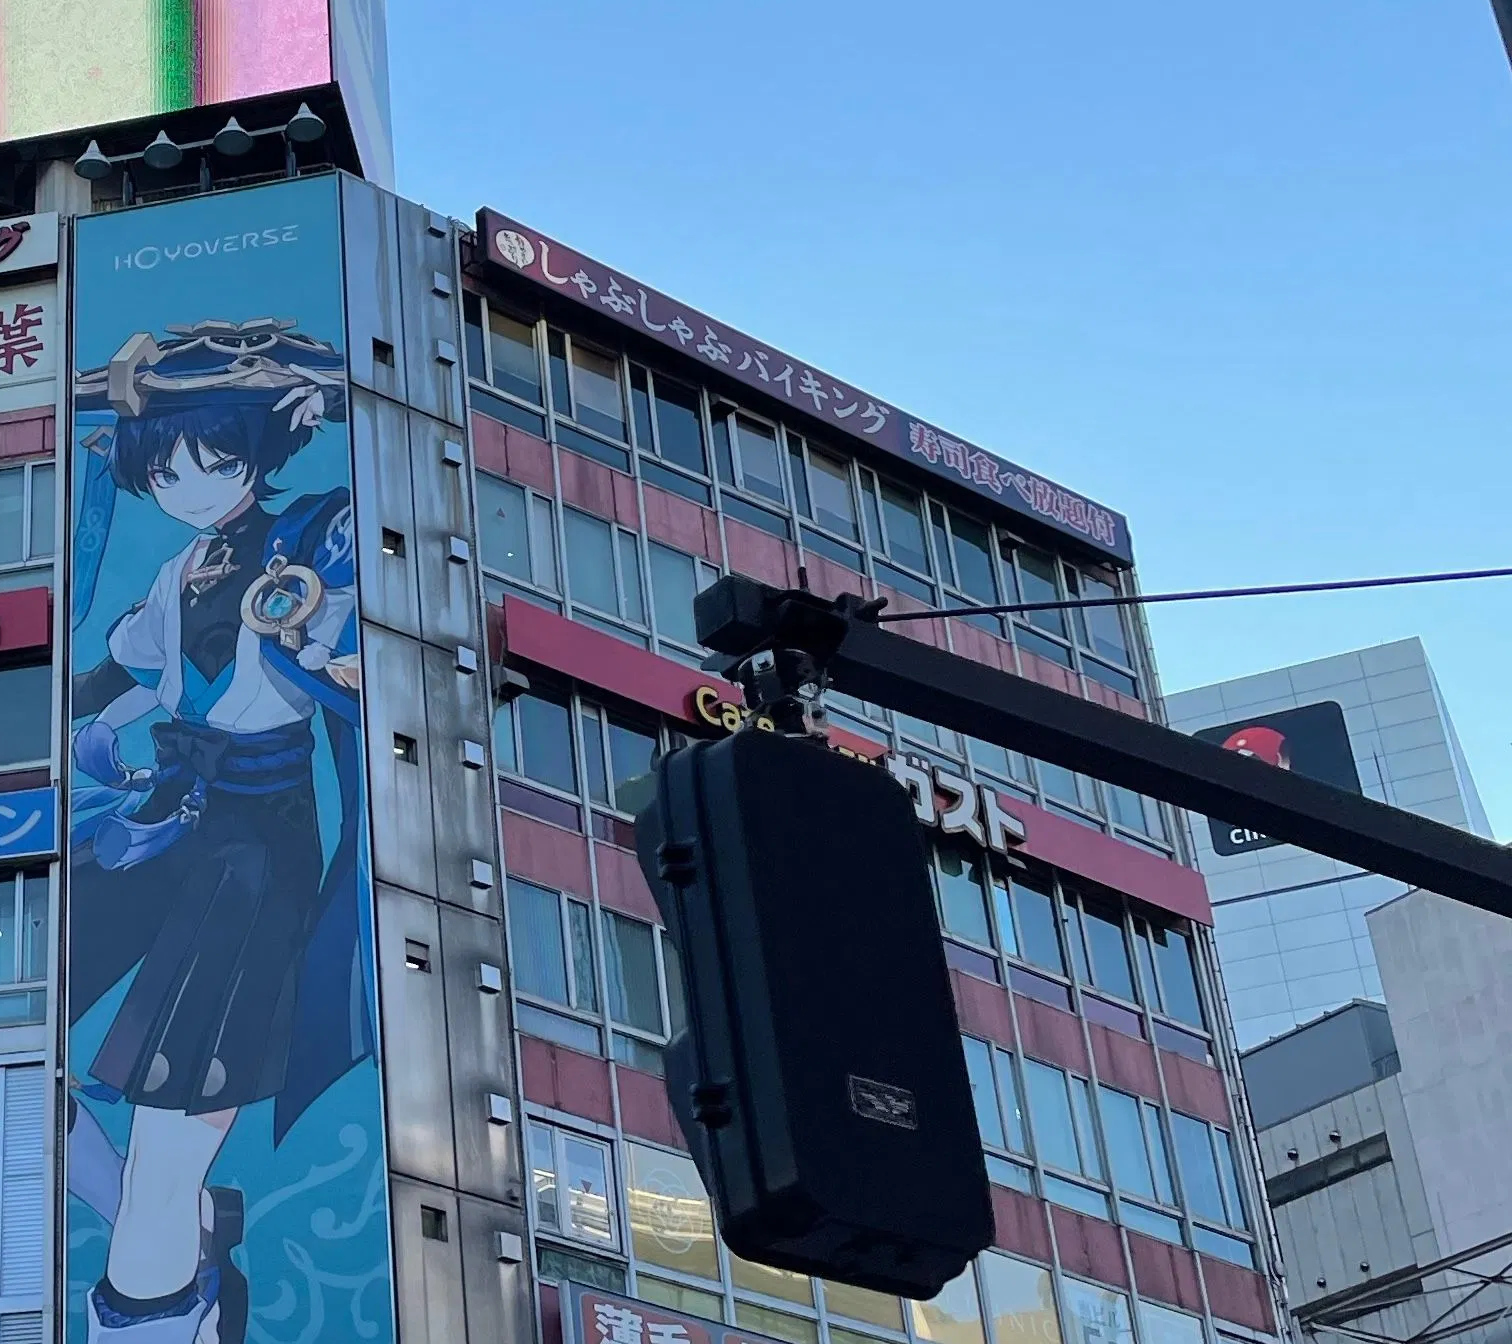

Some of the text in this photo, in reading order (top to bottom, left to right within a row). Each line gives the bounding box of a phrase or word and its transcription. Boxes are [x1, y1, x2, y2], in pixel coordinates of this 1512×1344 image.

[114, 224, 299, 271] HOYOVERSE
[539, 241, 1116, 546] しゃぶしゃぶバイキング 寿司食べ放題付
